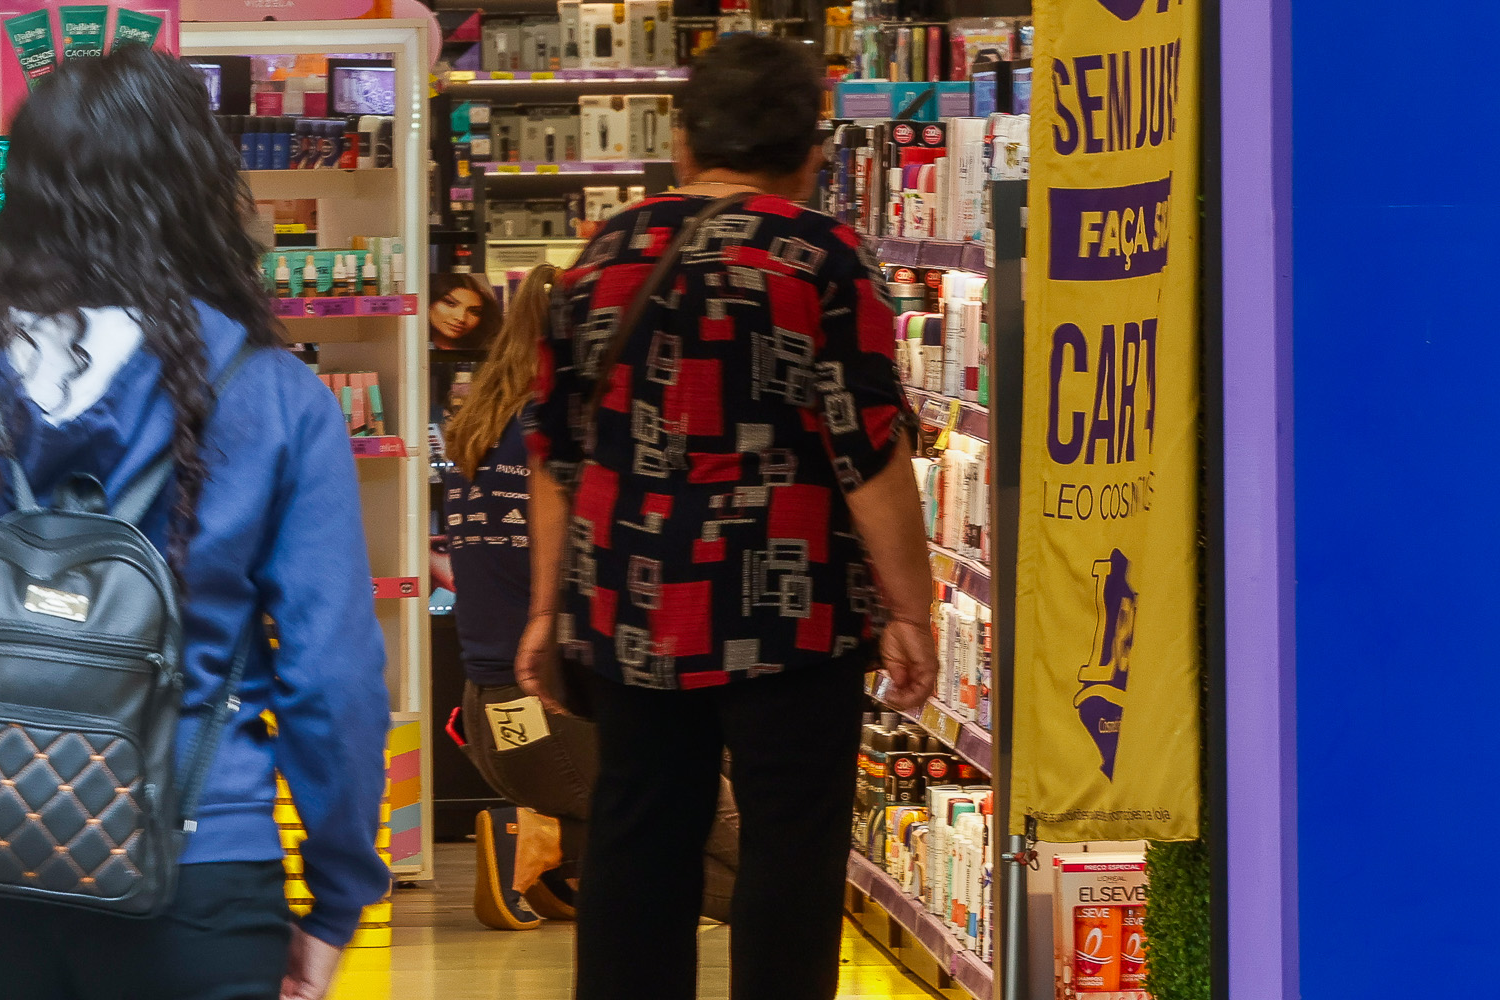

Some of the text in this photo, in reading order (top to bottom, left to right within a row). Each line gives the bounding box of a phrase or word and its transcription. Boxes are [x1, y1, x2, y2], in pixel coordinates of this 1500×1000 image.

[65, 50, 101, 58] CACHOS
[1052, 50, 1131, 156] SEM
[1078, 206, 1150, 271] FAÇA
[1043, 481, 1094, 521] LEO
[1078, 887, 1145, 902] ELSEVE
